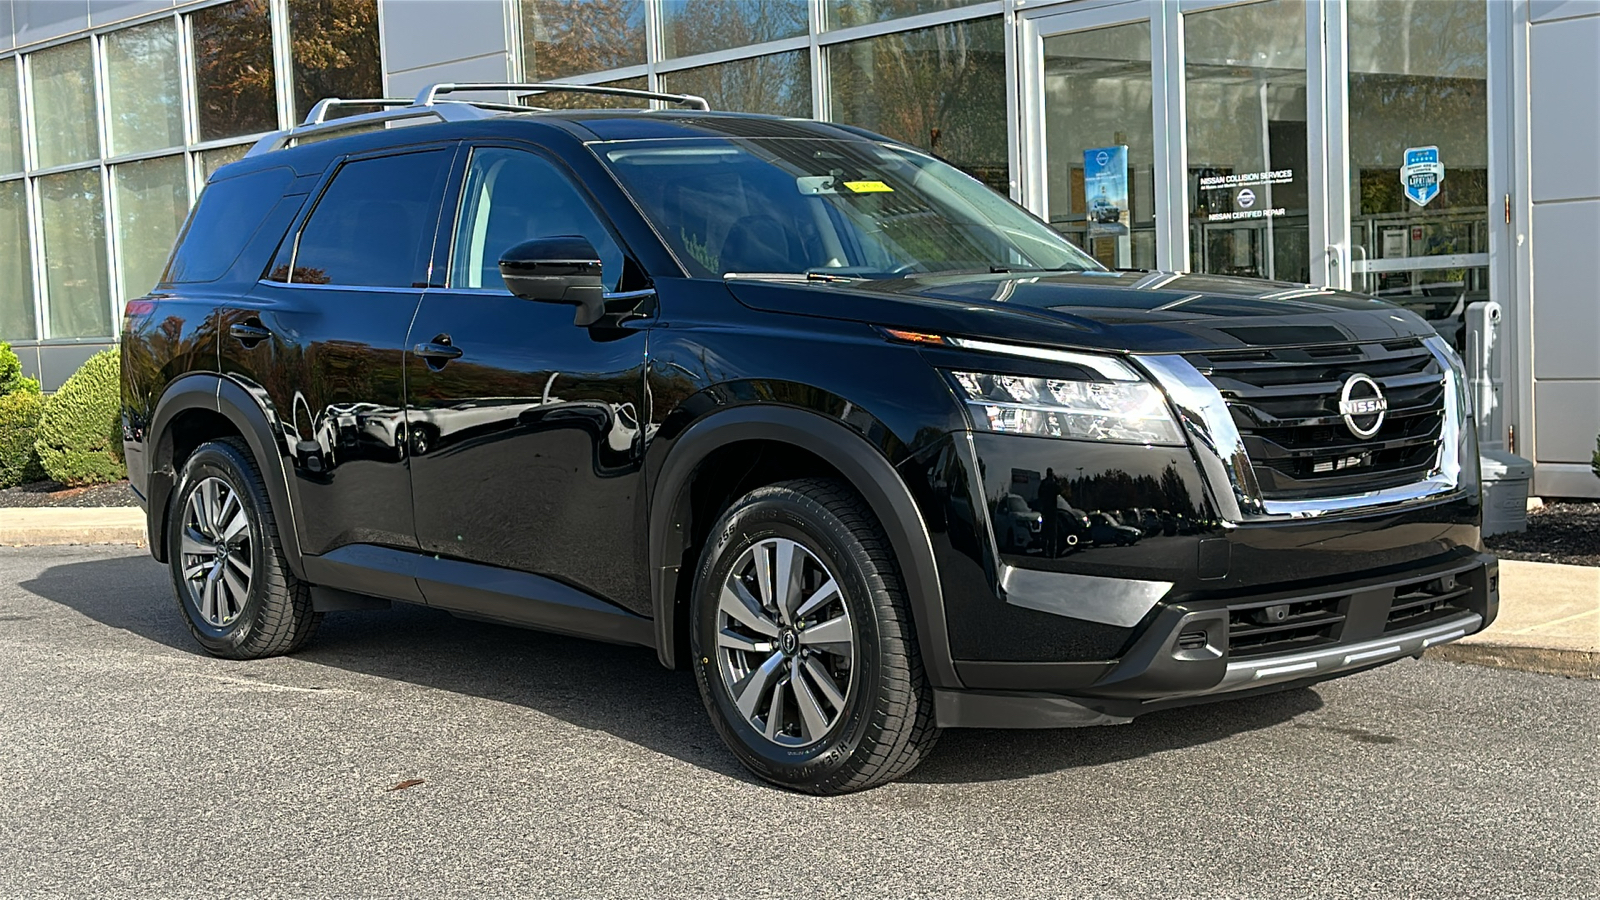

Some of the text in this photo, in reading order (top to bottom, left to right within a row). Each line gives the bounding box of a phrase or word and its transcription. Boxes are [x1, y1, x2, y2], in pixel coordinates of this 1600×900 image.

[1200, 170, 1293, 185] NISSAN COLLISION SERVICES
[1208, 208, 1286, 221] NISSAN CERTIFIED REPAIR
[1339, 399, 1388, 415] NISSAN
